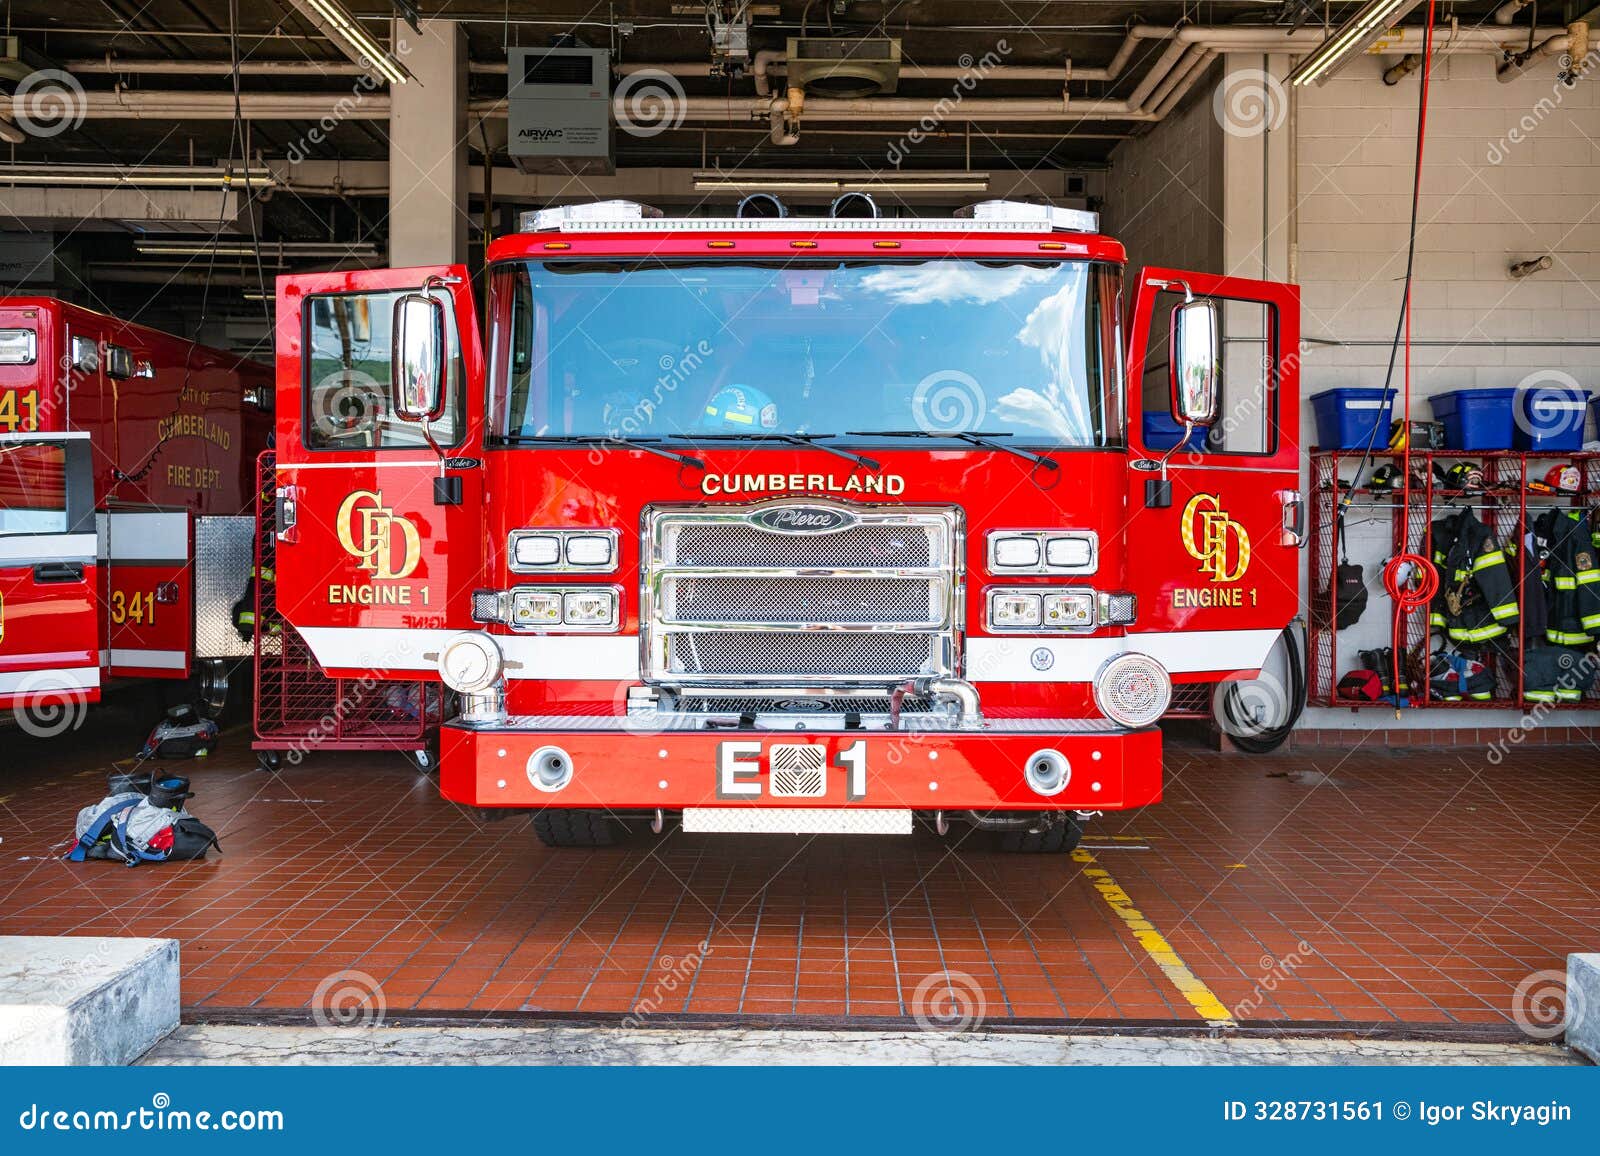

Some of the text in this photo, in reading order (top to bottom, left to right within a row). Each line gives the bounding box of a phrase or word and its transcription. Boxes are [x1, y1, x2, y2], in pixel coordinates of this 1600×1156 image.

[518, 129, 563, 137] AIRVAC
[158, 414, 231, 451] CUMBERLAND
[167, 464, 192, 488] FIRE
[701, 473, 905, 496] CUMBERLAND
[772, 507, 834, 528] Pierce
[328, 585, 430, 605] ENGINE 1
[1173, 588, 1258, 608] ENGINE 1
[111, 590, 155, 625] 341
[718, 740, 866, 799] E 1
